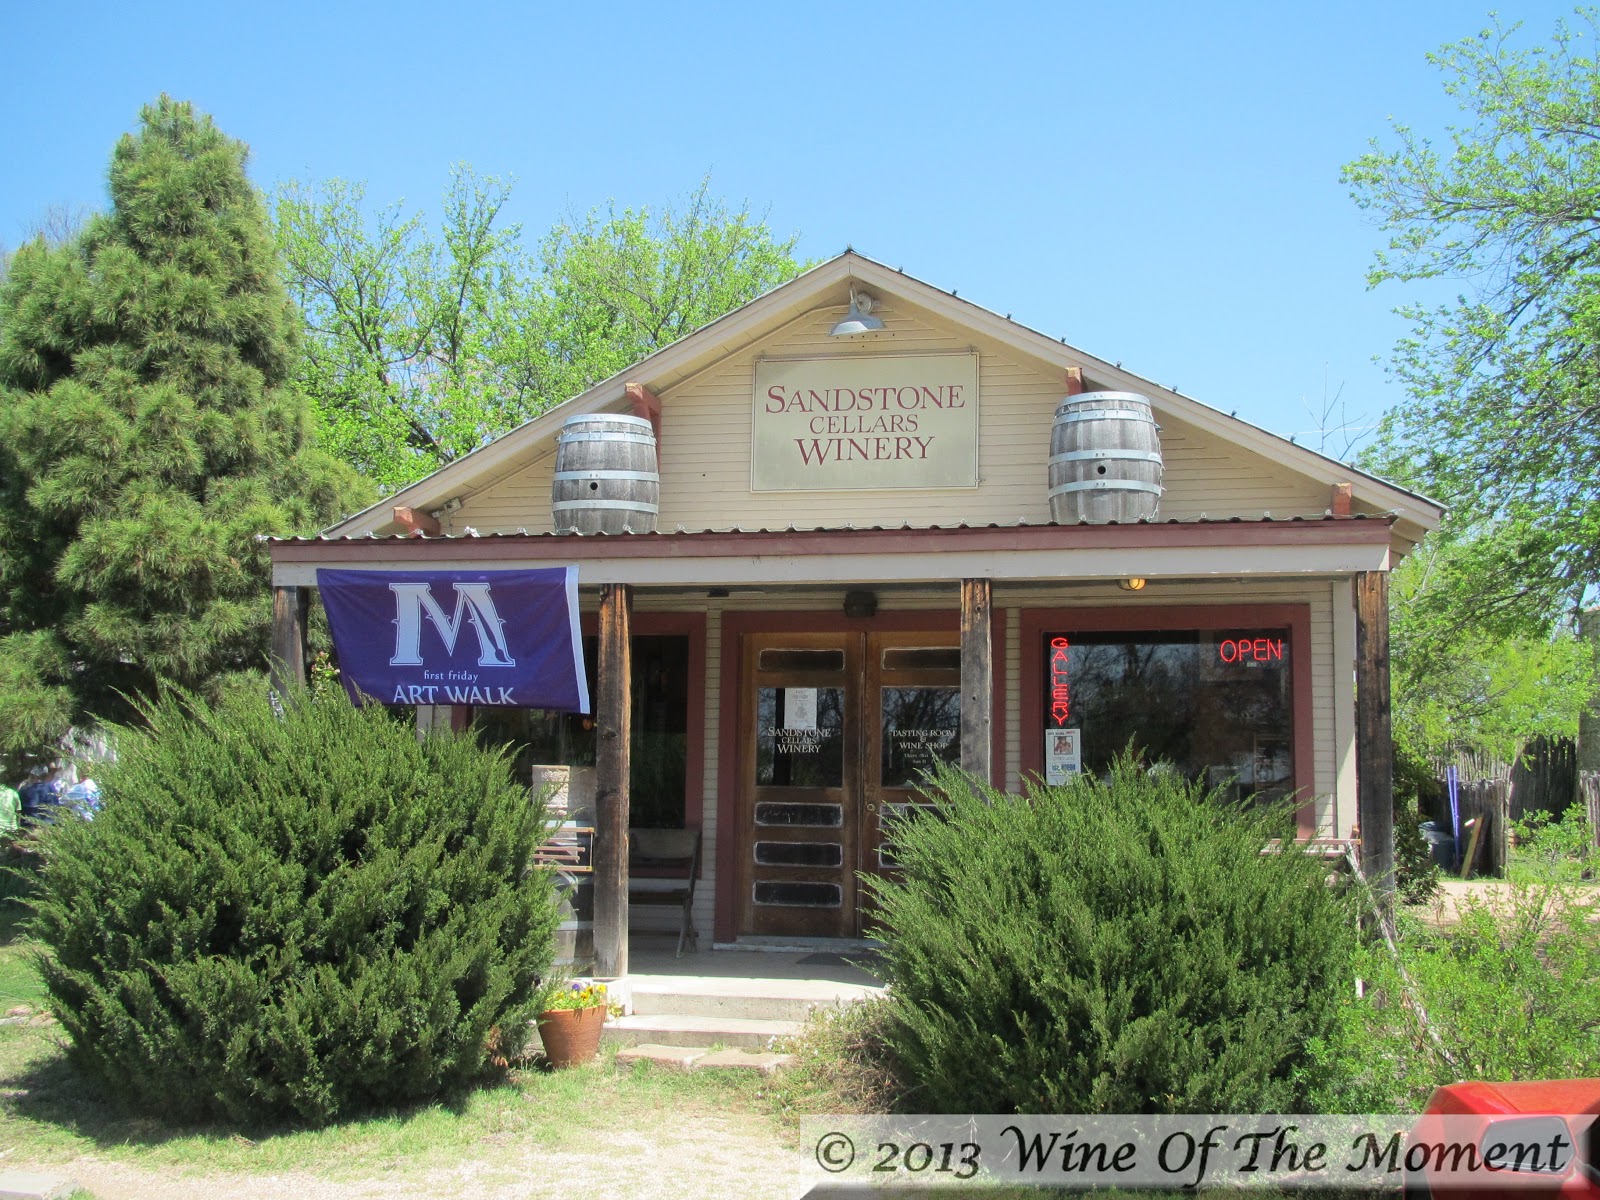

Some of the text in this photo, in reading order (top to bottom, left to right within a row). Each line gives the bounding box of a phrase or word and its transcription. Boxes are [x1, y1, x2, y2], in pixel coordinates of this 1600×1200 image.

[765, 385, 966, 414] SANDSTONE
[809, 414, 918, 434] CELLARS
[794, 436, 935, 466] WINERY
[388, 582, 516, 667] M
[1220, 639, 1282, 662] OPEN
[424, 669, 479, 683] first friday
[1050, 637, 1069, 726] GALLERY
[393, 685, 518, 705] ART WALK
[767, 726, 831, 737] SANDSTONE
[892, 729, 956, 737] TASTING ROOM
[777, 744, 822, 753] WINERY
